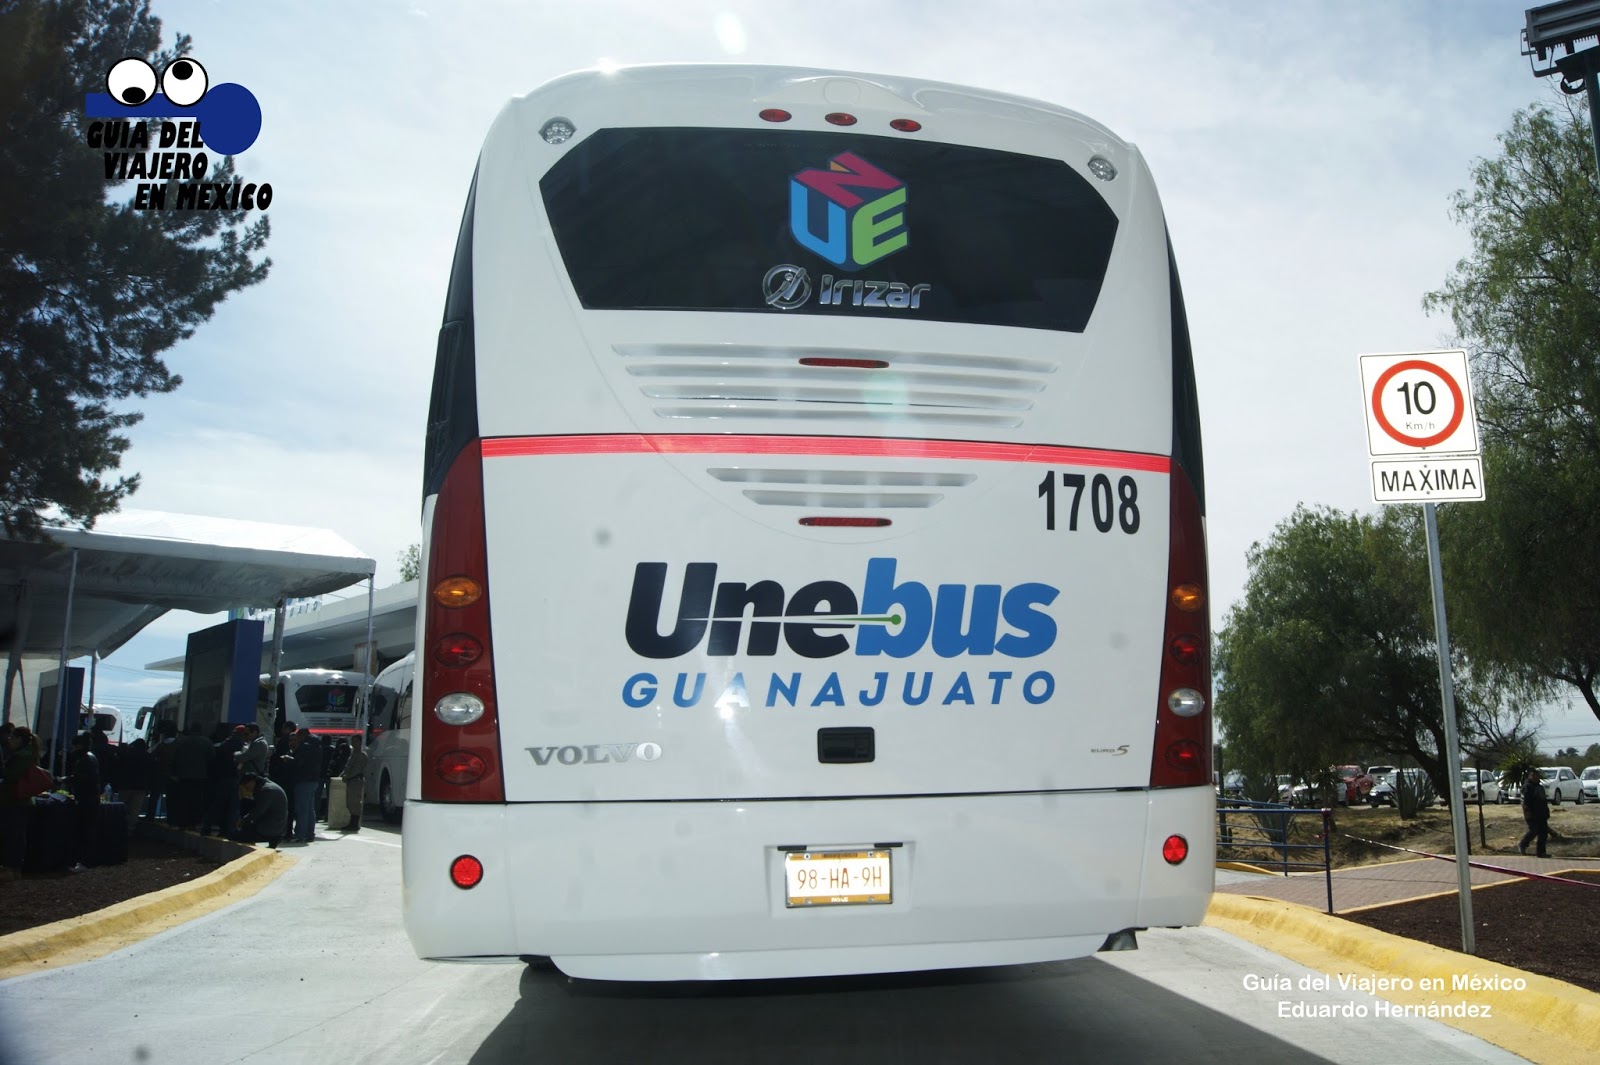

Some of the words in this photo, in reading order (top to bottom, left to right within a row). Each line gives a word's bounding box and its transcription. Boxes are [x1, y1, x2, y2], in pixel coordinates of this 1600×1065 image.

[819, 274, 932, 309] Irizar
[1397, 381, 1436, 415] 10
[1405, 421, 1436, 430] Km/h
[1381, 468, 1477, 493] MAXIMA
[1038, 470, 1141, 535] 1708
[624, 557, 1061, 659] Unebus
[622, 669, 1056, 708] GUANAJUATO
[524, 742, 662, 766] VOLVO
[797, 866, 882, 890] 98-HA-9H
